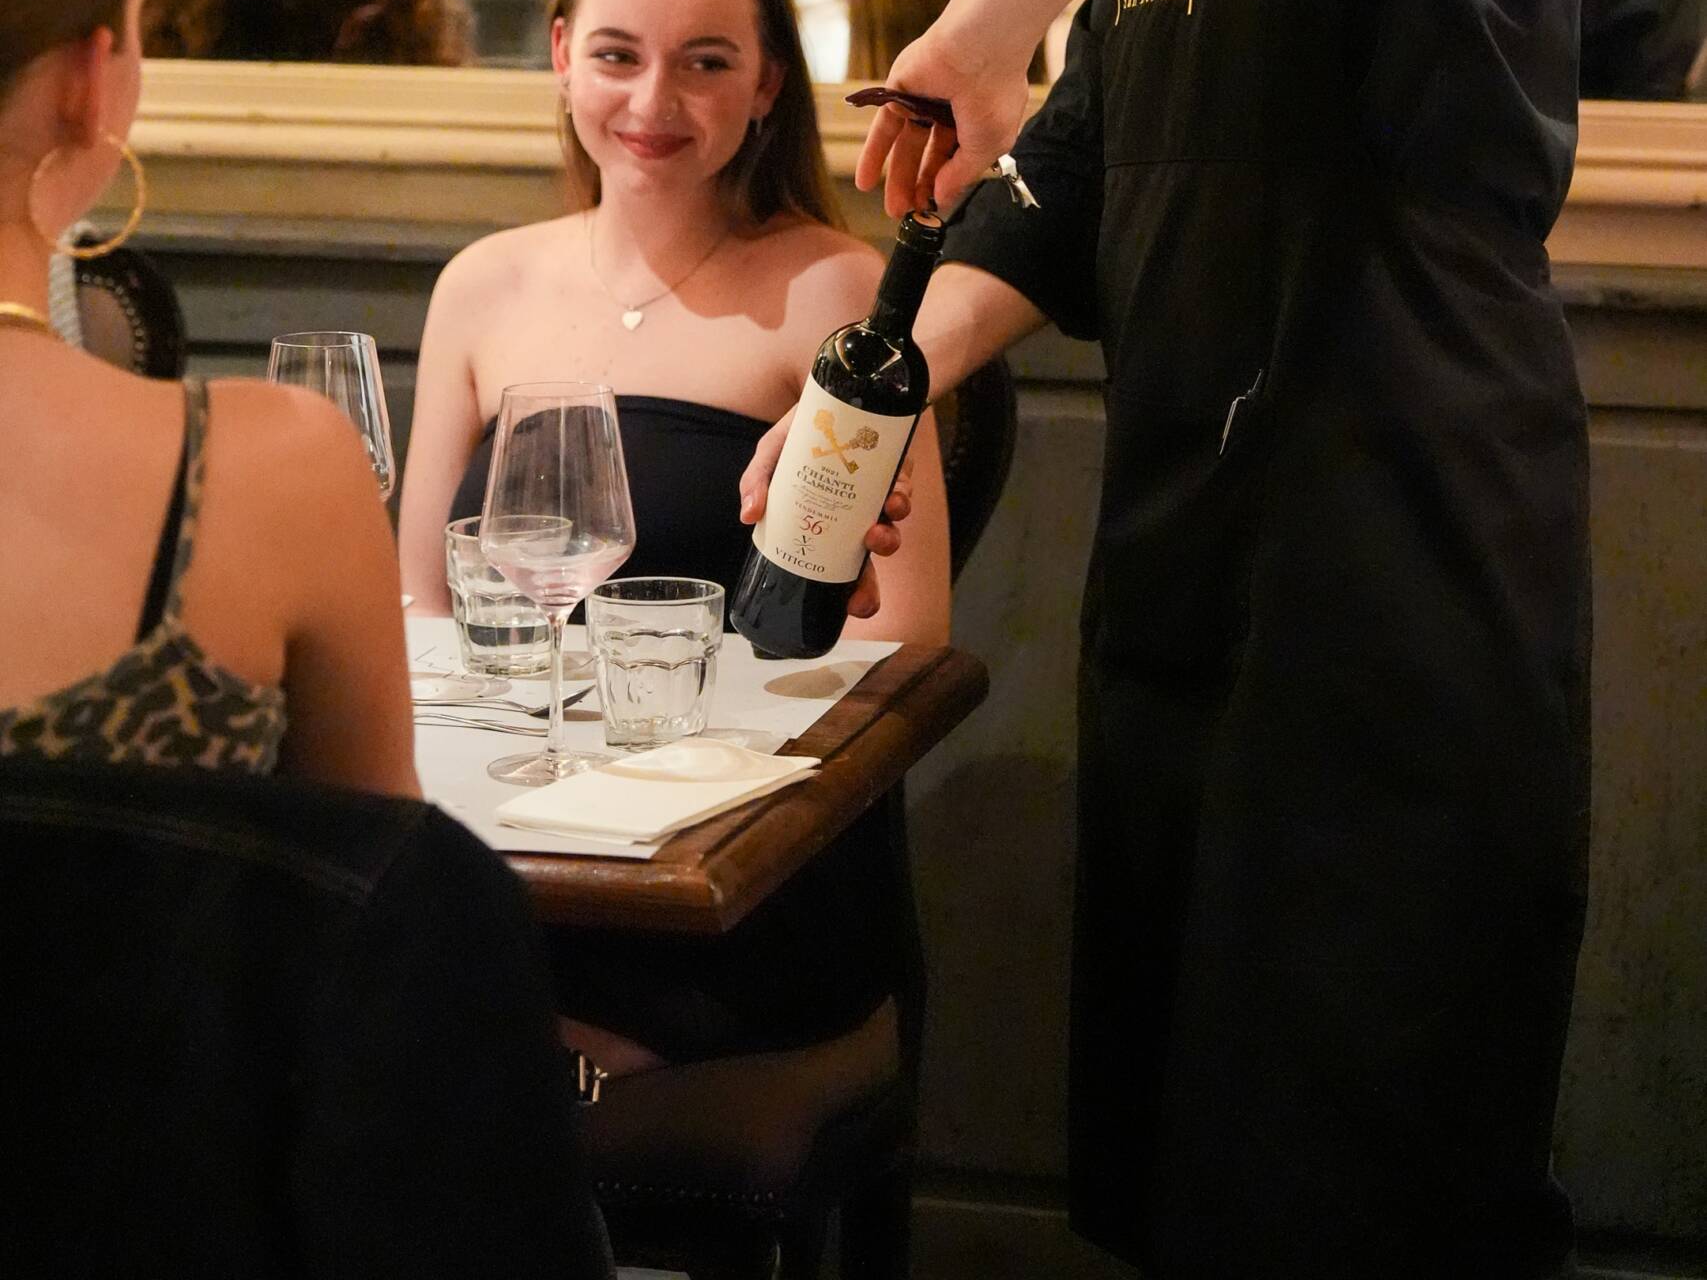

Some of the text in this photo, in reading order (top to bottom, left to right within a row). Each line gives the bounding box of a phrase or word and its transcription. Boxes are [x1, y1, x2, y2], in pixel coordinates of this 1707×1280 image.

[797, 470, 857, 499] CLASSICO
[802, 465, 855, 491] CHIANTI
[775, 547, 825, 573] VITICCIO
